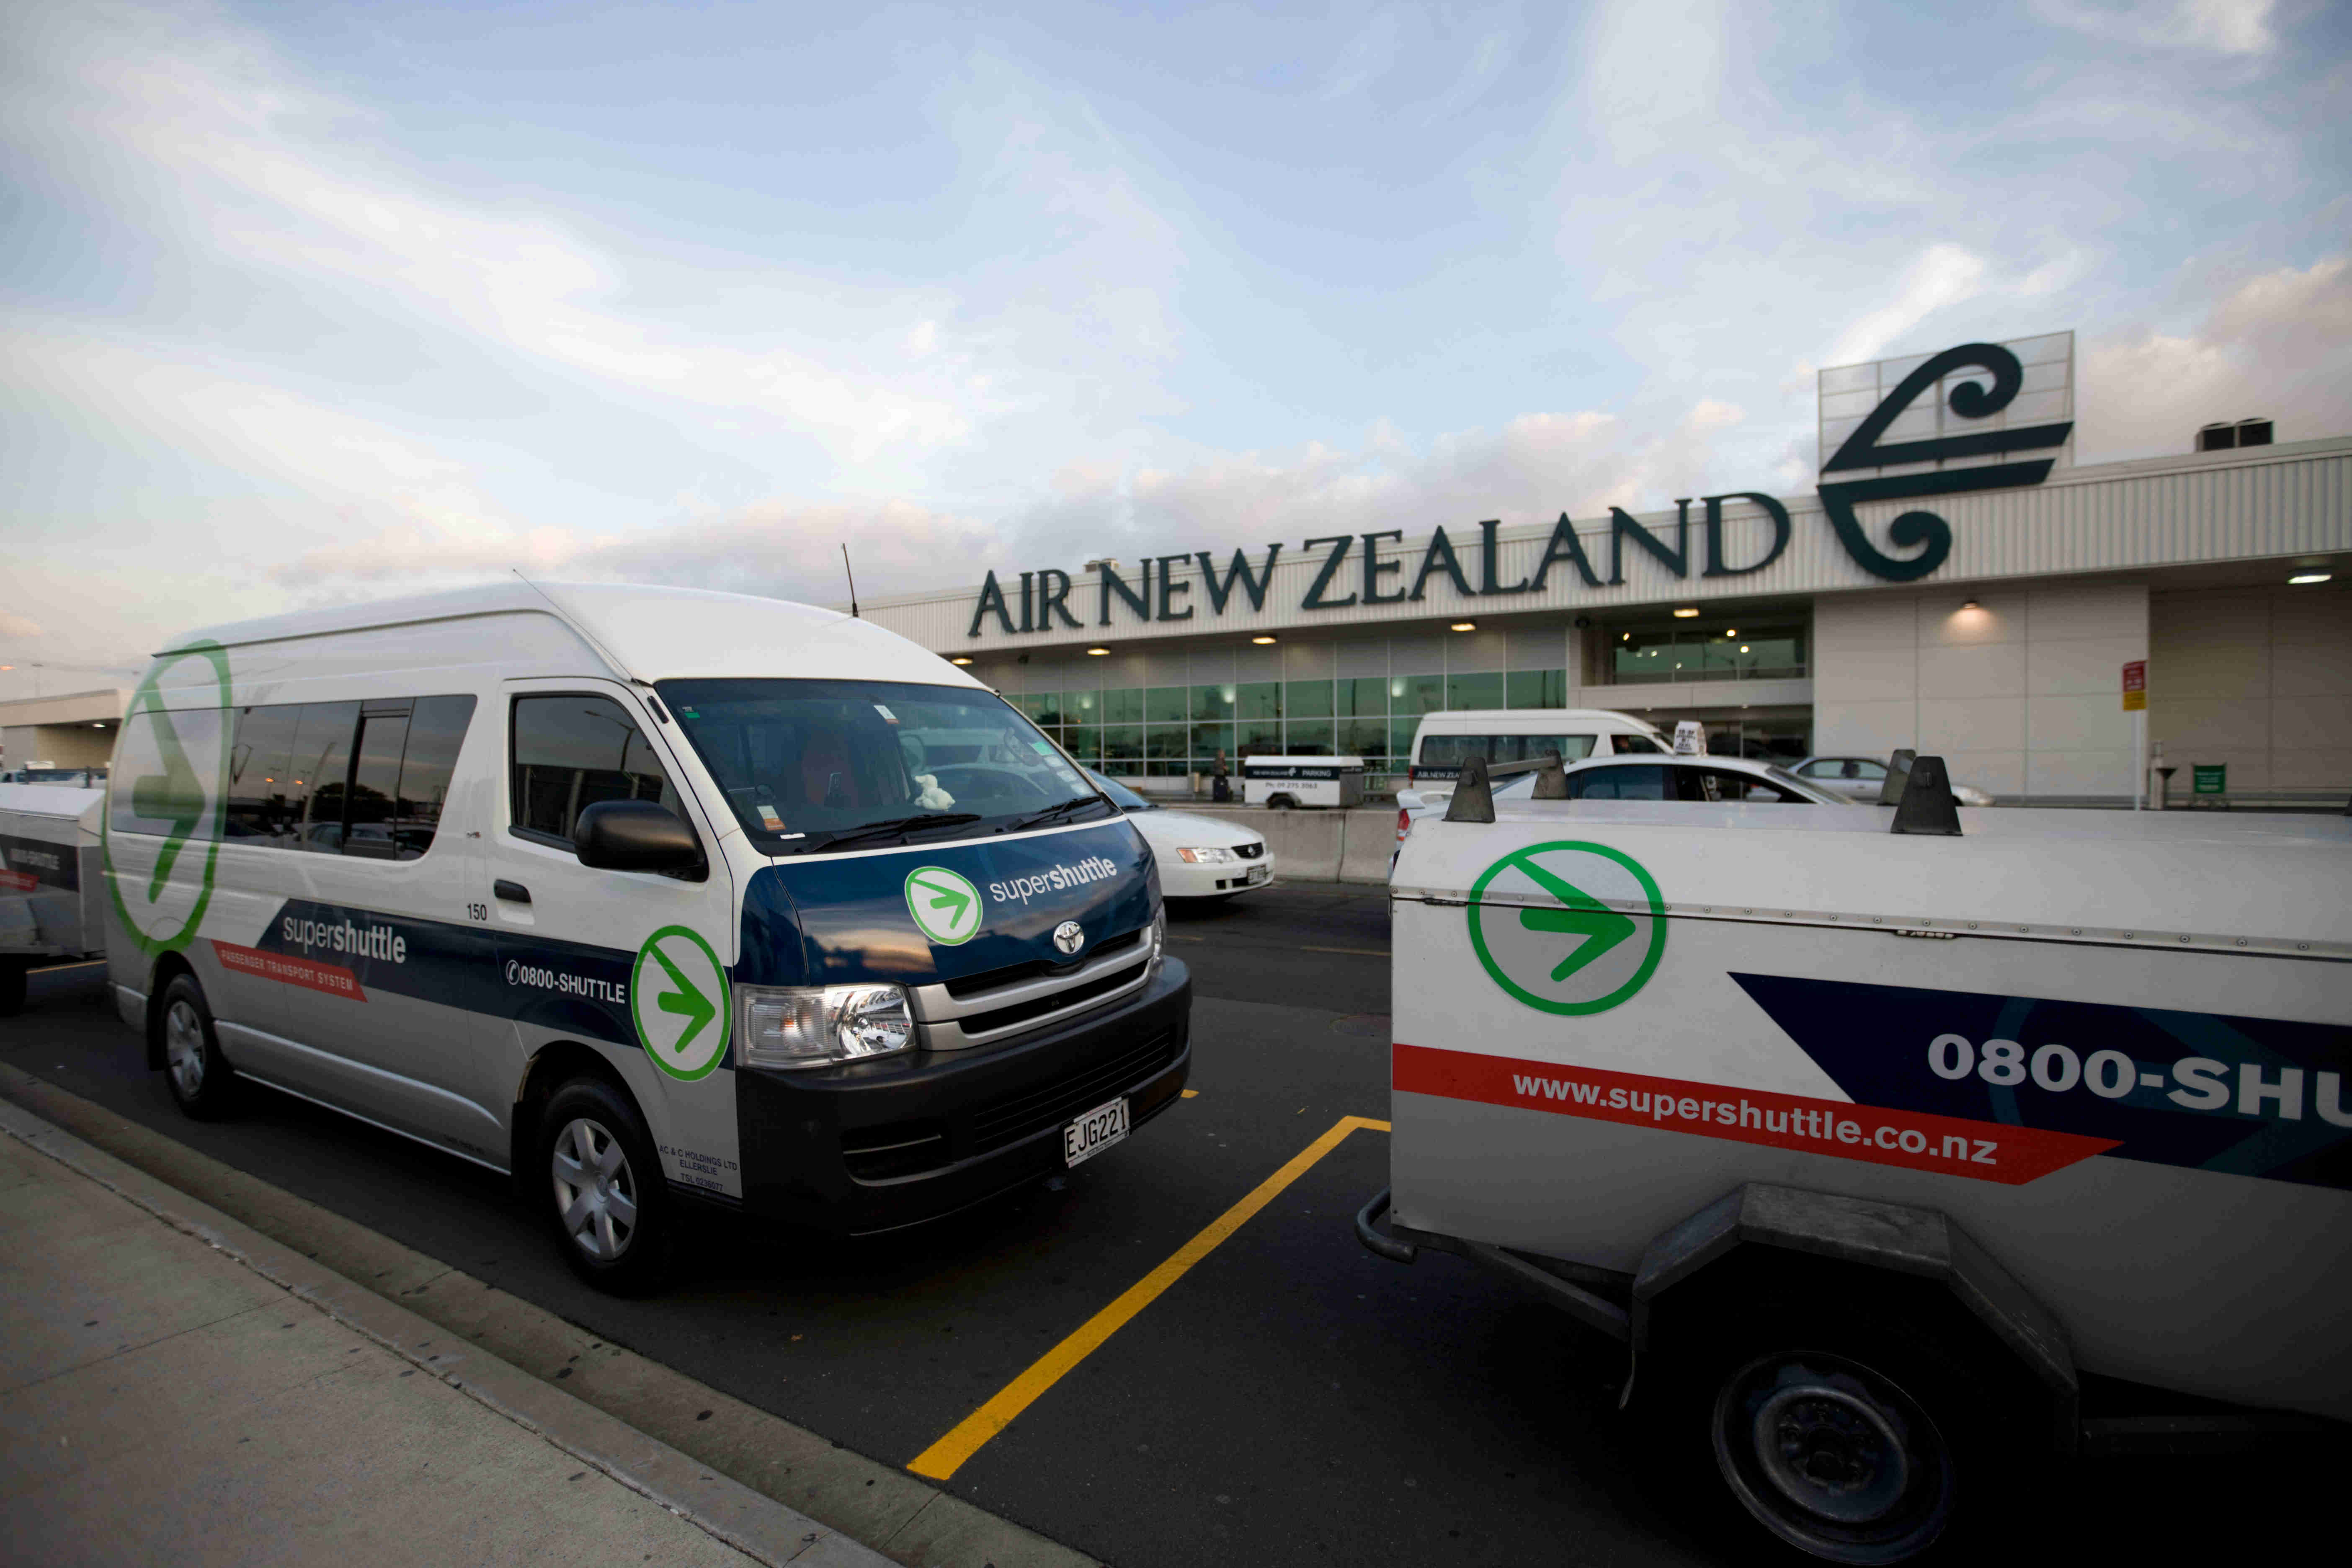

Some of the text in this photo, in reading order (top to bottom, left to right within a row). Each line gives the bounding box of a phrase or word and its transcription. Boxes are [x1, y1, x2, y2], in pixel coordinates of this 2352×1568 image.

[968, 491, 1791, 637] AIR NEW ZEALAND
[990, 856, 1117, 905] supershuttle
[467, 903, 487, 921] 150
[283, 917, 406, 964] supershuttle
[221, 949, 354, 991] PASSENGER TRANSPORT SYSTEM
[520, 966, 625, 1004] 0800-SHUTTLE
[1927, 1033, 2352, 1128] 0800-SHU
[1066, 1104, 1126, 1159] EJG221
[1513, 1074, 1998, 1165] www.supershuttle.co.nz
[659, 1145, 738, 1171] AC & C HOLDINGS LTD
[680, 1159, 718, 1176] ELLERSLIE
